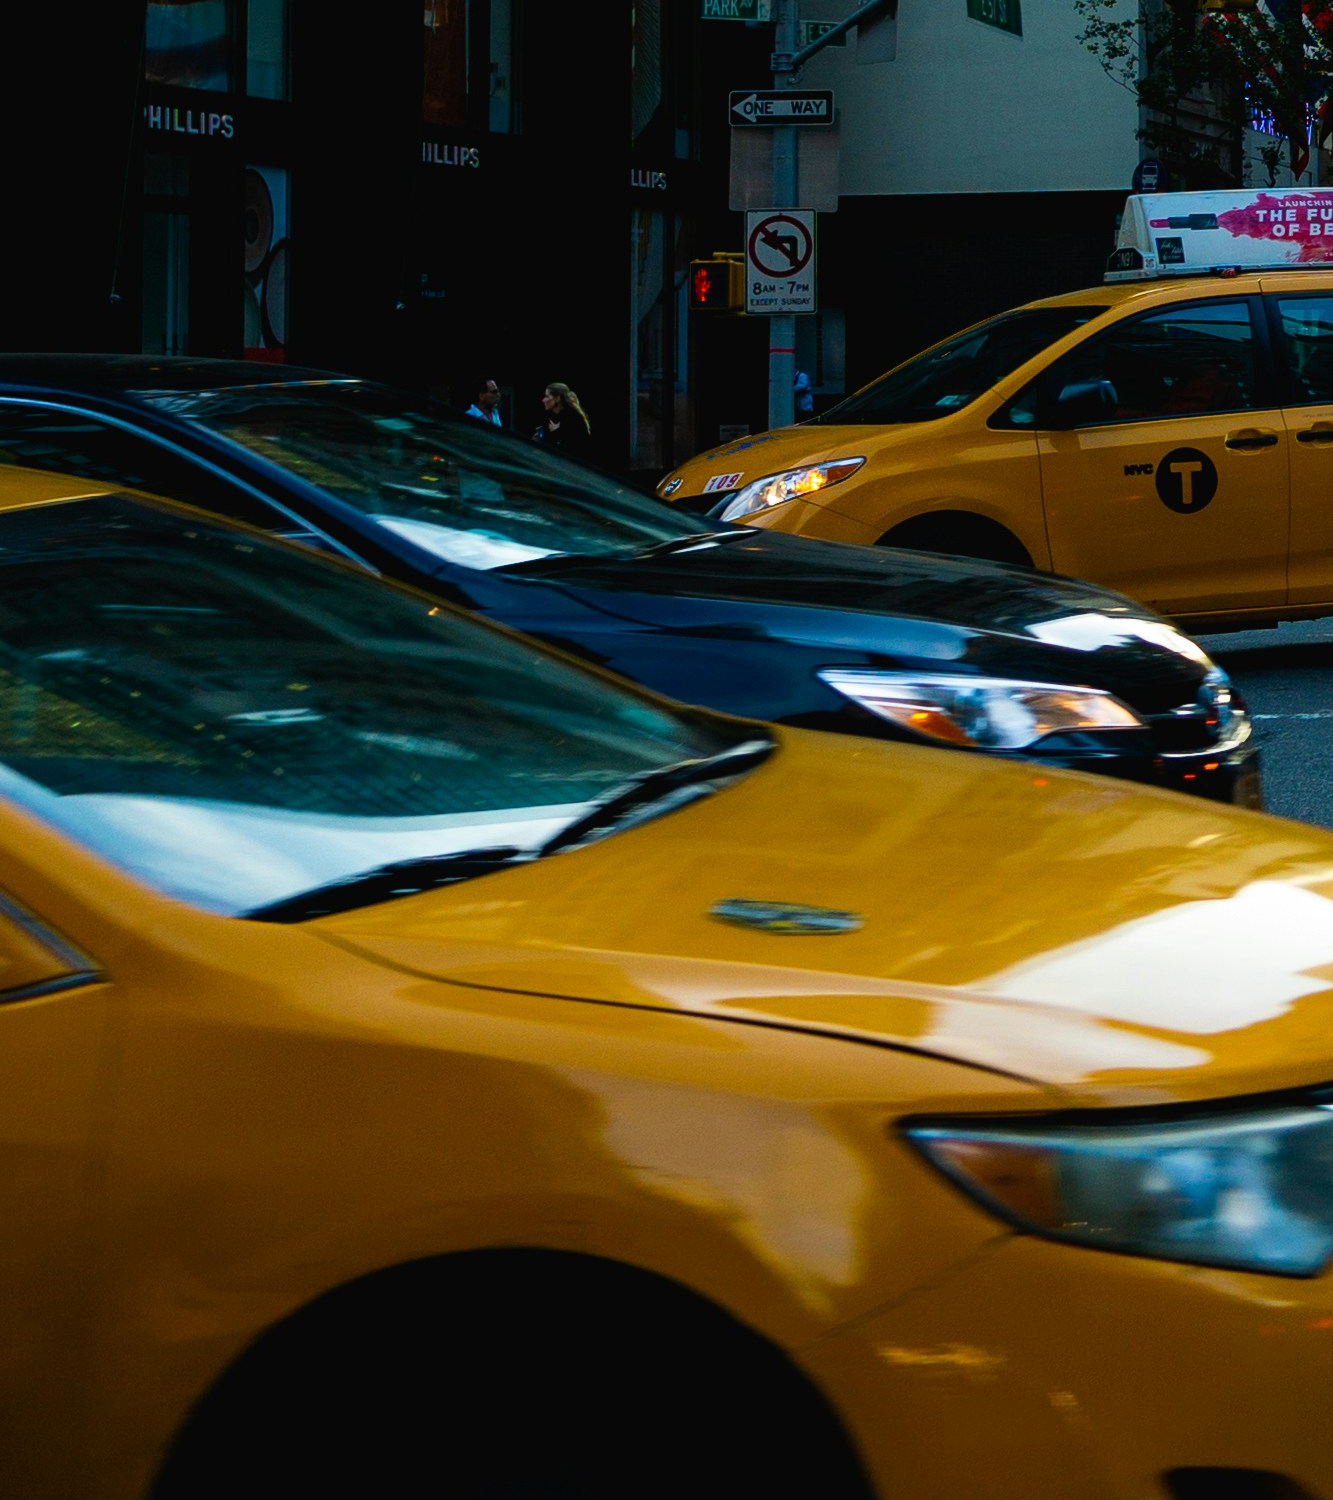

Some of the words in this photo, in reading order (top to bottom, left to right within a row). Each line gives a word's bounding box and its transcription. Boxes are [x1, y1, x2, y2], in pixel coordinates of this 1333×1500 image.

[743, 101, 774, 115] ONE
[790, 101, 824, 114] WAY
[143, 104, 235, 139] HILLIPS
[1256, 209, 1297, 223] THE
[1272, 223, 1300, 237] OF
[752, 281, 776, 294] 8AM
[787, 281, 809, 294] 7PM
[751, 298, 778, 306] EXCEPT
[781, 297, 811, 306] SUNDAY
[1124, 463, 1153, 477] NYC
[1169, 460, 1203, 505] T
